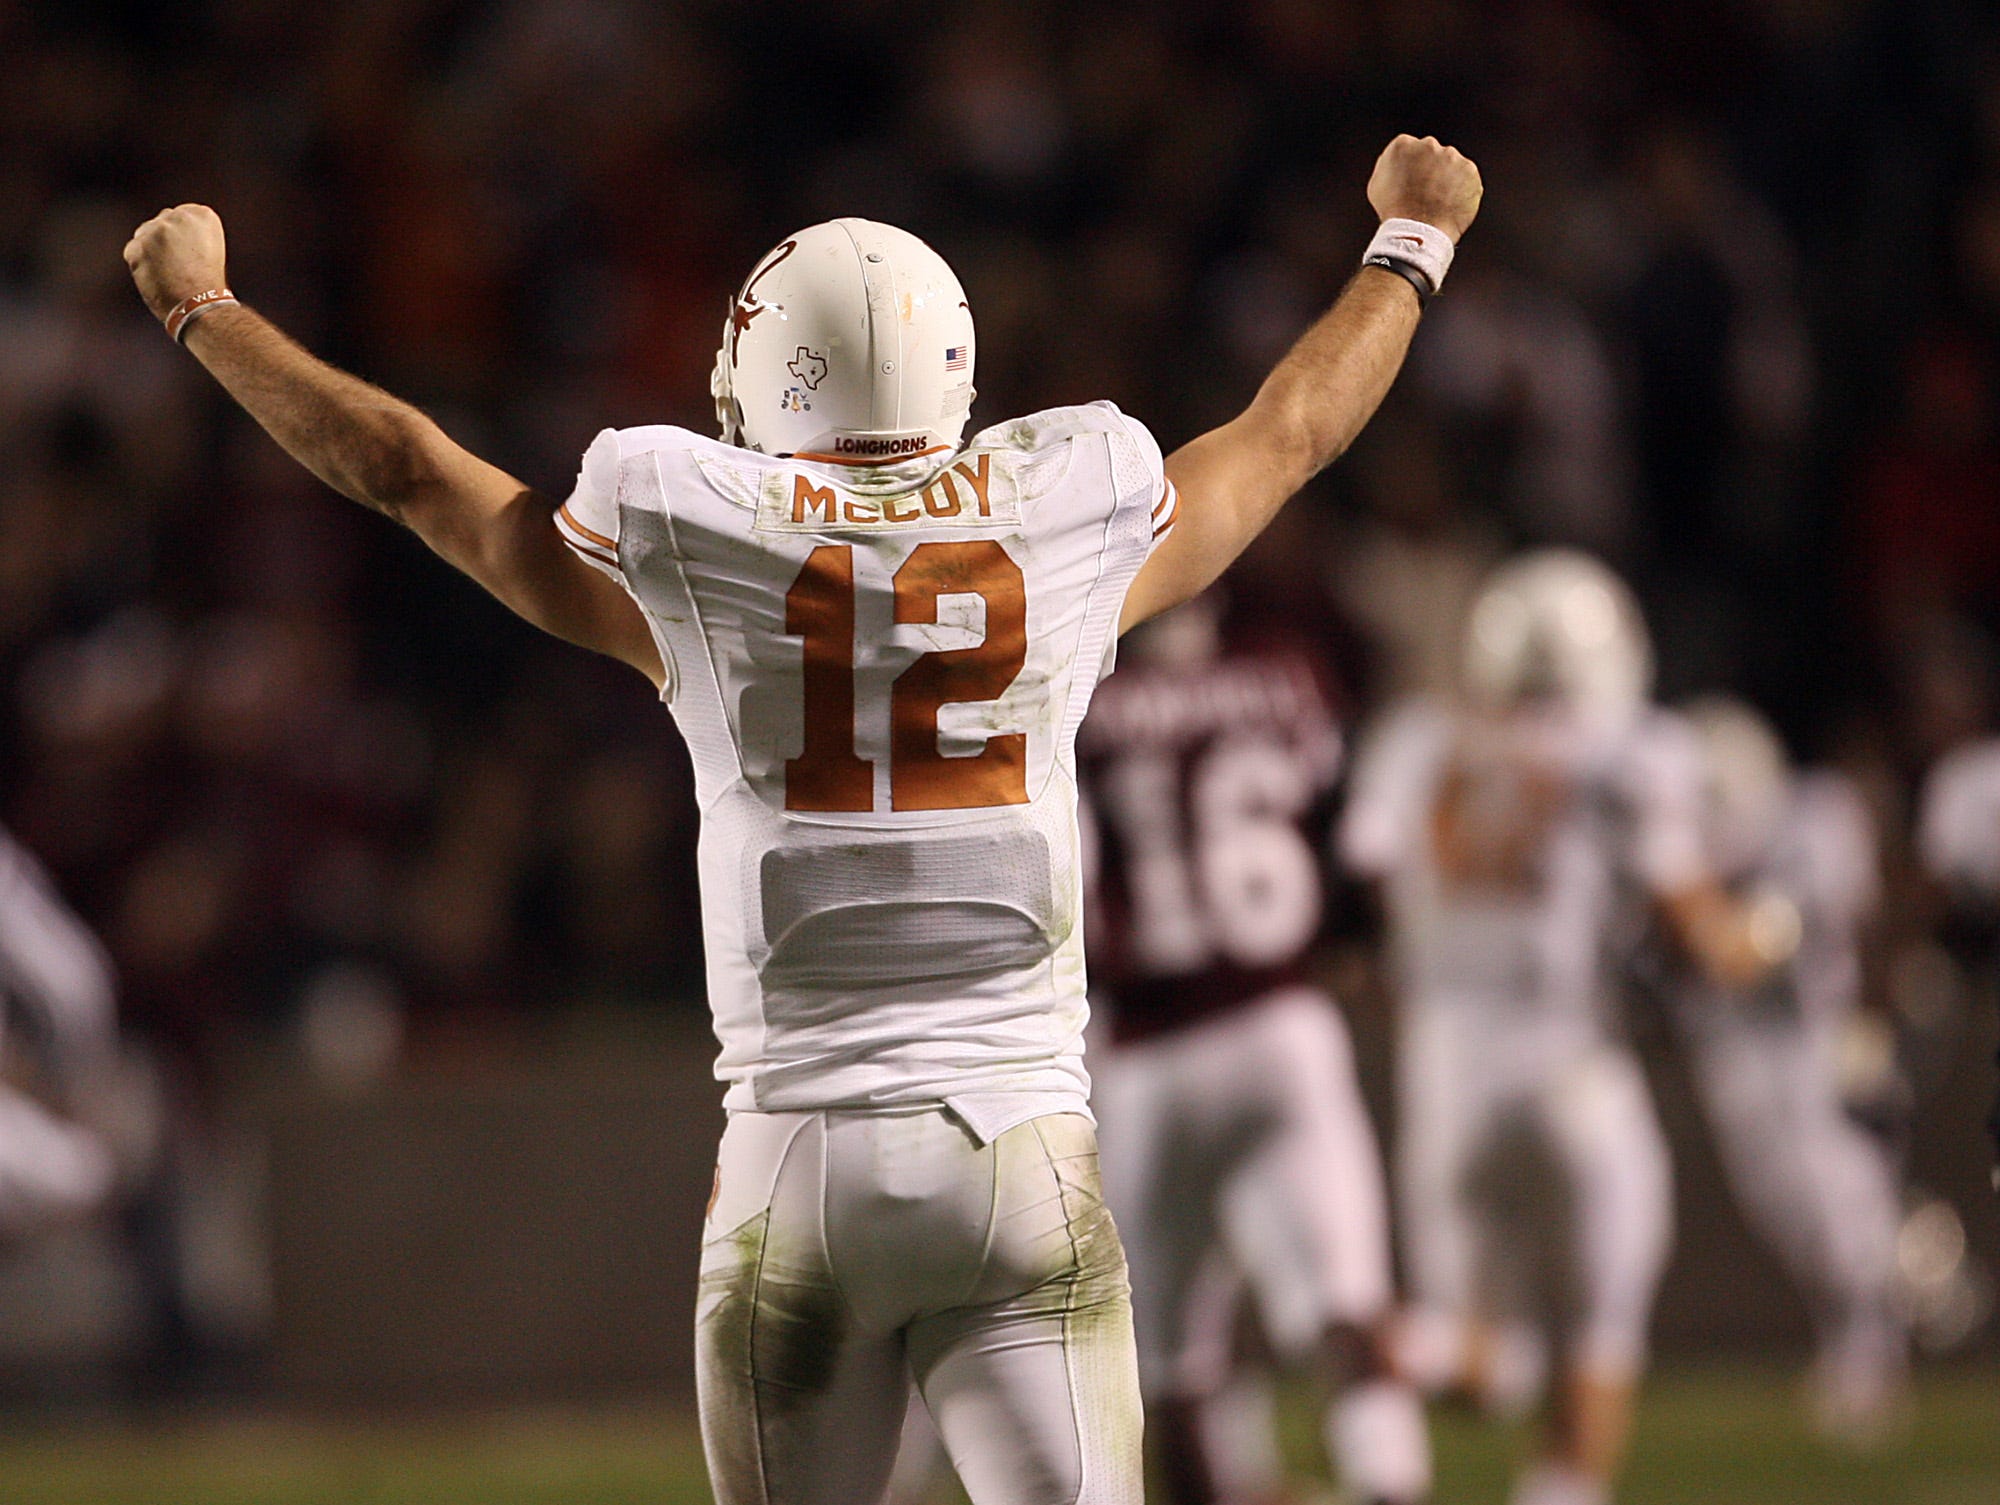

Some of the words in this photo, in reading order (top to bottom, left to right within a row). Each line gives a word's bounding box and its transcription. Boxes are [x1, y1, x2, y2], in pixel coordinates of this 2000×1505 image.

[192, 289, 218, 303] WE
[835, 436, 927, 453] LONGHORNS
[785, 540, 1031, 812] 12
[1102, 738, 1324, 966] 16
